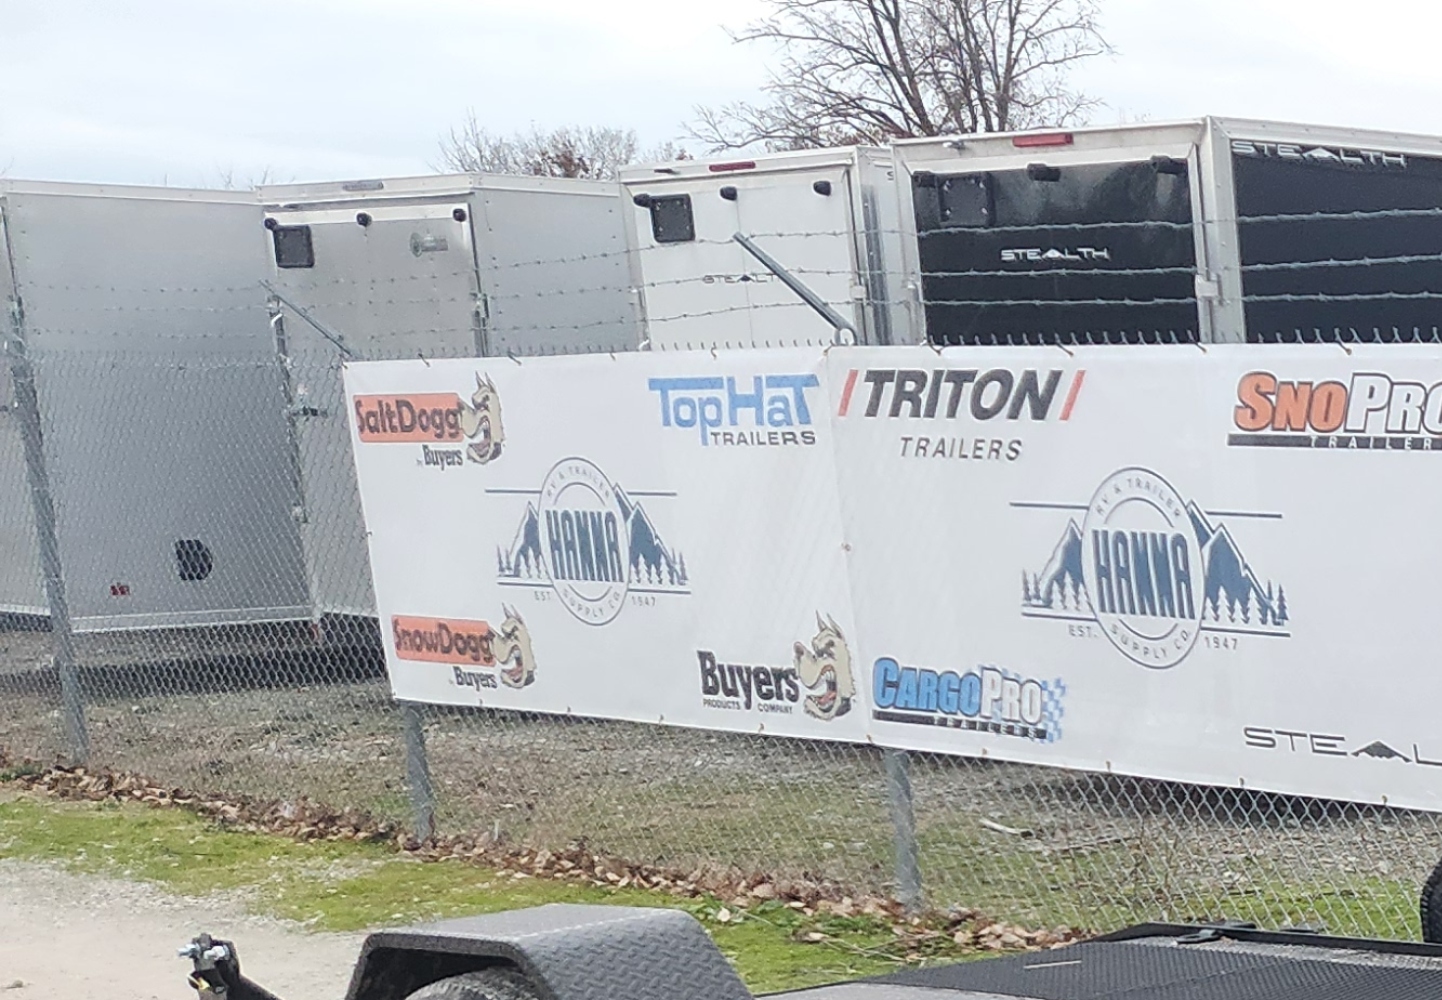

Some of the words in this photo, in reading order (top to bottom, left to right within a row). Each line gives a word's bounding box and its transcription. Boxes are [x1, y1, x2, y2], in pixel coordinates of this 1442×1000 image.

[1231, 140, 1407, 168] STEALTH
[1001, 247, 1111, 261] STEALTH
[702, 273, 780, 284] STEALT
[864, 369, 1064, 421] TRITON
[355, 400, 461, 439] SaltDogg
[710, 430, 816, 446] TRAILERS
[900, 437, 1023, 462] TRAILERS
[422, 444, 463, 471] Buyers
[569, 466, 610, 498] TRAILER
[1126, 478, 1181, 518] TRAILER
[545, 510, 625, 583] HANNA
[1092, 530, 1195, 621] HANNA
[631, 596, 656, 607] 1947
[393, 618, 494, 664] SnowDogg
[1068, 625, 1098, 638] EST.
[1110, 624, 1168, 659] SUPPLY
[1205, 637, 1238, 651] 1947
[452, 665, 498, 692] Buyers
[696, 650, 800, 711] Buyers
[703, 698, 741, 711] PRODUCTS
[757, 703, 793, 715] COMPANY
